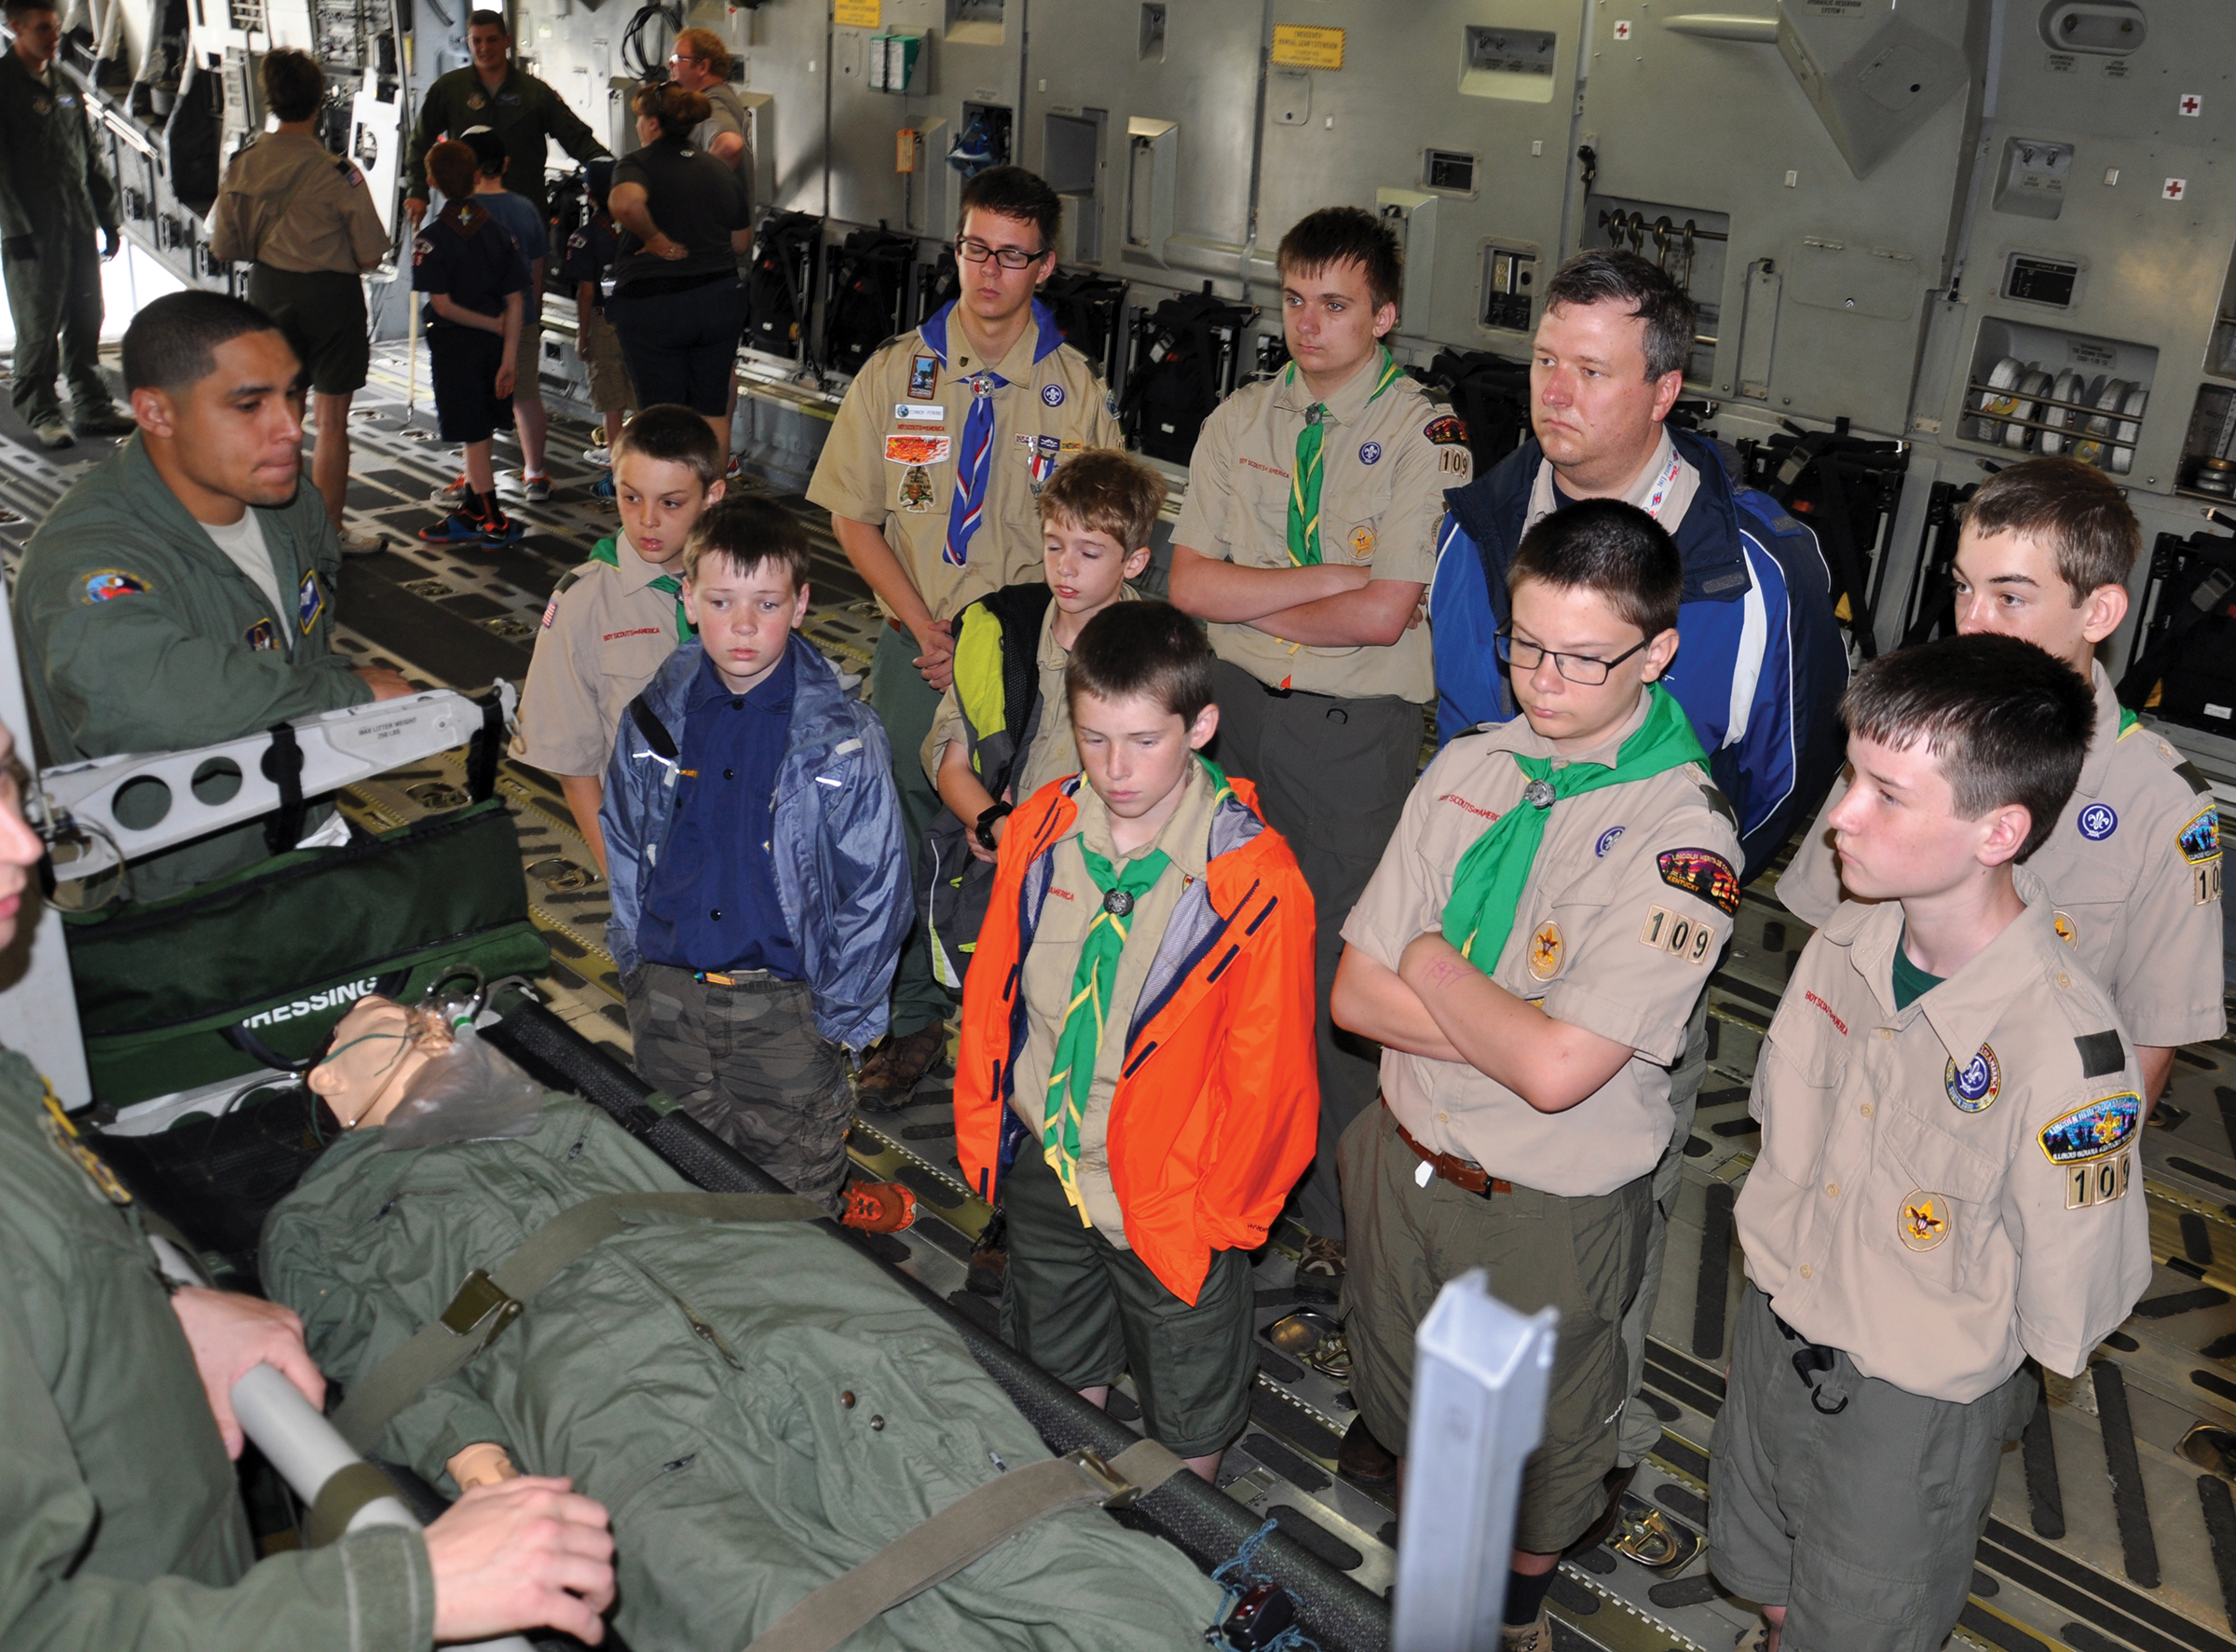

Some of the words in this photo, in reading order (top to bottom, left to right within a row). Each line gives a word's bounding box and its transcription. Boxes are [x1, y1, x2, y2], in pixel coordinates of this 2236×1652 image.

[1248, 460, 1265, 471] SCOUTS
[1268, 468, 1289, 478] AMERICA
[1444, 451, 1467, 475] 109
[603, 634, 613, 642] BOY
[613, 630, 634, 639] SCOUTS
[358, 728, 372, 736] MAX
[373, 722, 392, 732] LITTER
[394, 717, 416, 727] WEIGHT
[1449, 794, 1475, 812] SCOUTS
[1667, 875, 1700, 892] KENTUCKY
[1651, 911, 1708, 960] 109
[1806, 990, 1818, 1003] BOY
[1988, 1055, 1998, 1089] AMERICA
[2049, 1114, 2078, 1135] LINCOLN
